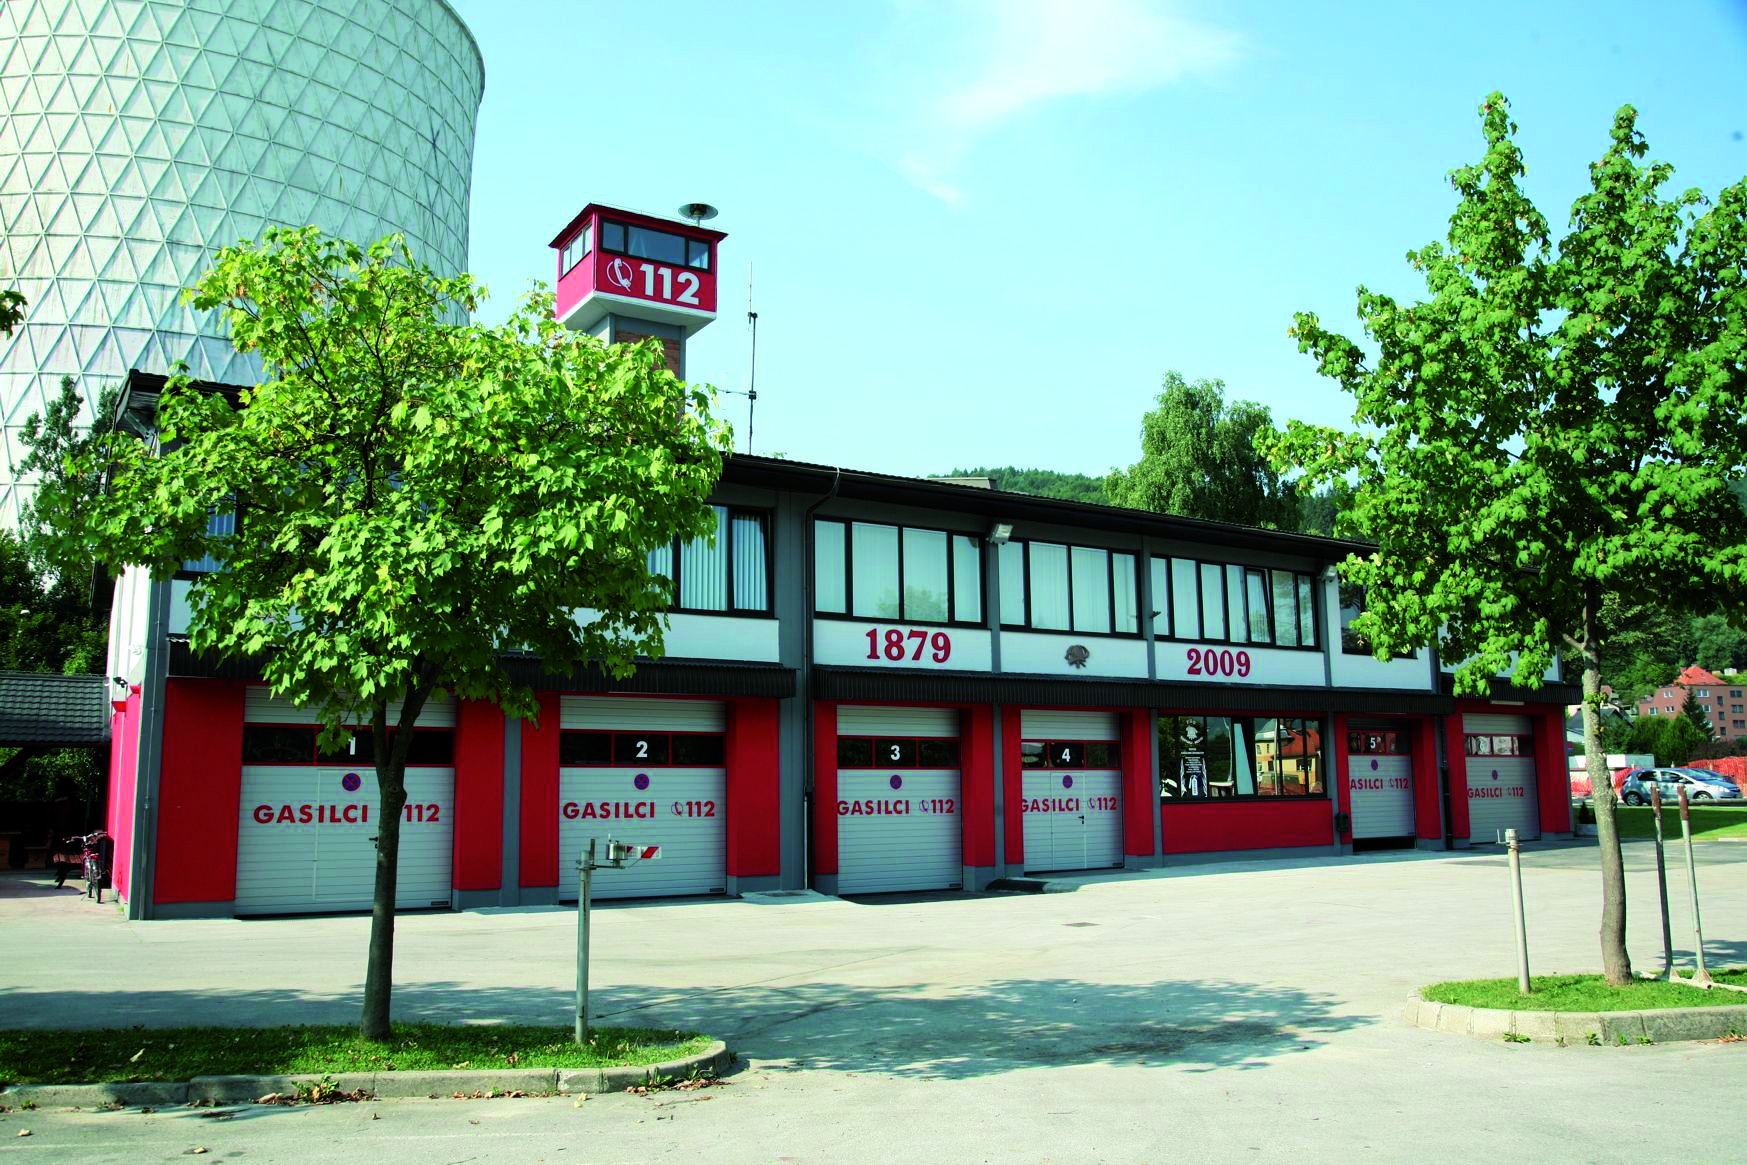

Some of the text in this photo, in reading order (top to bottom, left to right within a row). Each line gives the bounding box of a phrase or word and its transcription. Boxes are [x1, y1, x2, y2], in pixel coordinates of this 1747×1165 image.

[640, 263, 700, 306] 112
[865, 628, 952, 663] 1879
[1186, 648, 1252, 678] 2009
[348, 736, 356, 756] 1
[635, 740, 649, 758] 2
[1370, 737, 1376, 749] 5
[890, 744, 901, 761] 3
[1061, 748, 1071, 762] 4
[1350, 778, 1384, 790] ASILCI
[1467, 786, 1525, 799] GASILCI 112
[252, 803, 441, 824] GASILCI 112
[562, 800, 716, 820] GASILCI 112
[837, 798, 955, 816] GASILCI 112
[1021, 796, 1118, 813] GASILCI 112
